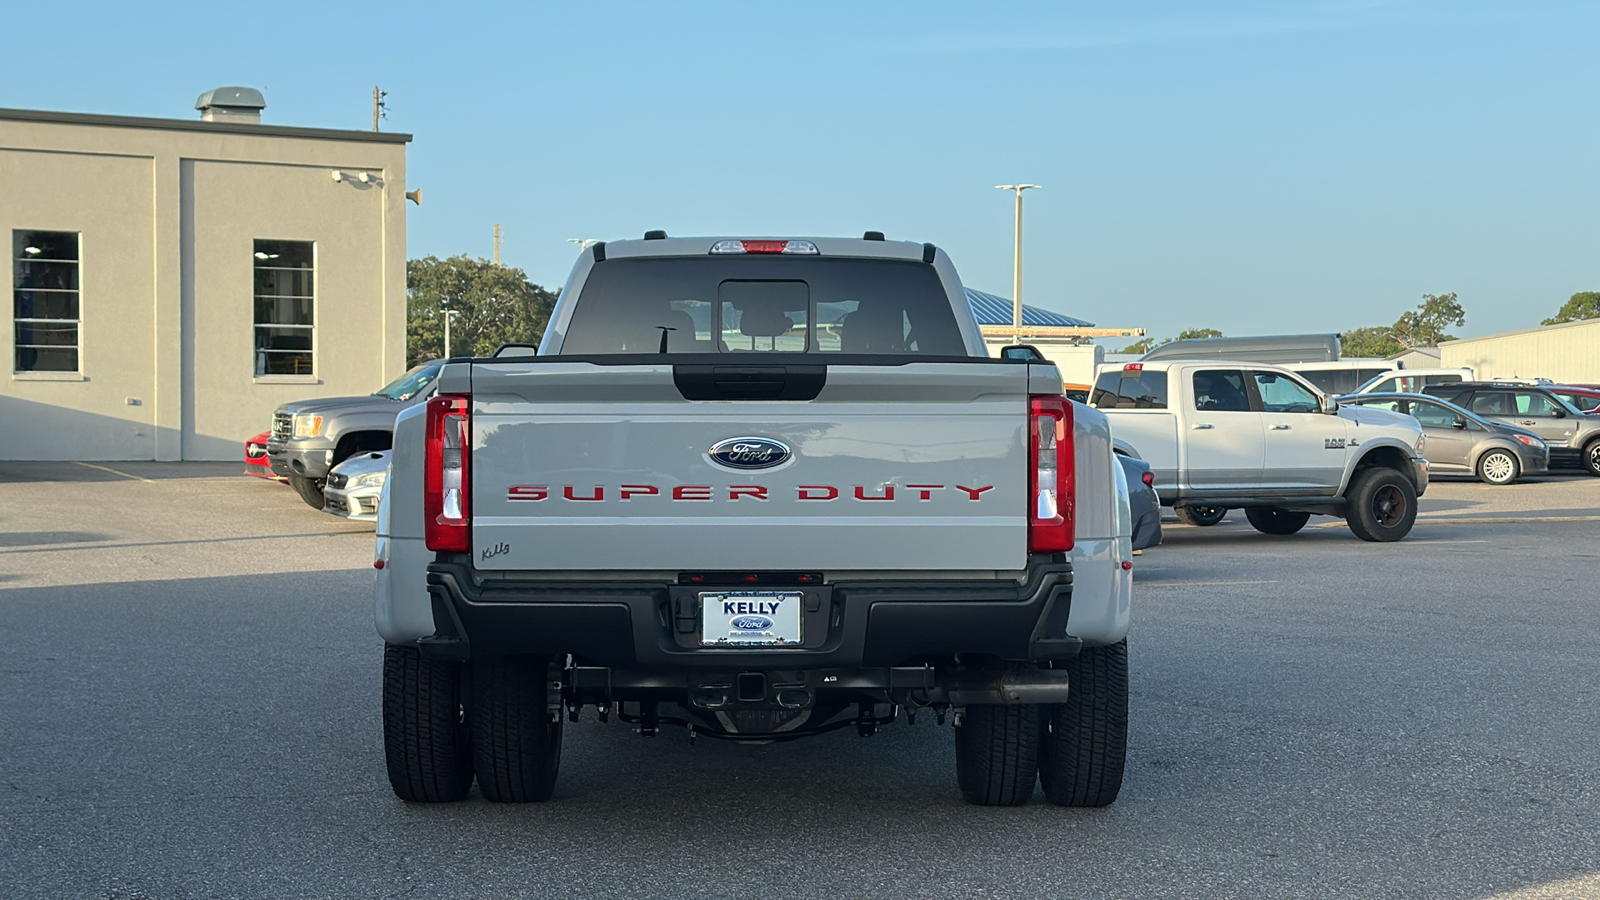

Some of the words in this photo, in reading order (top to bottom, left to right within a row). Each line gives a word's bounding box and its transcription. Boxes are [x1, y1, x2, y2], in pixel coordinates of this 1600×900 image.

[729, 443, 773, 461] Ford
[507, 485, 773, 502] SUPER
[796, 485, 994, 502] DUTY
[723, 602, 780, 614] KELLY
[738, 617, 764, 629] Ford
